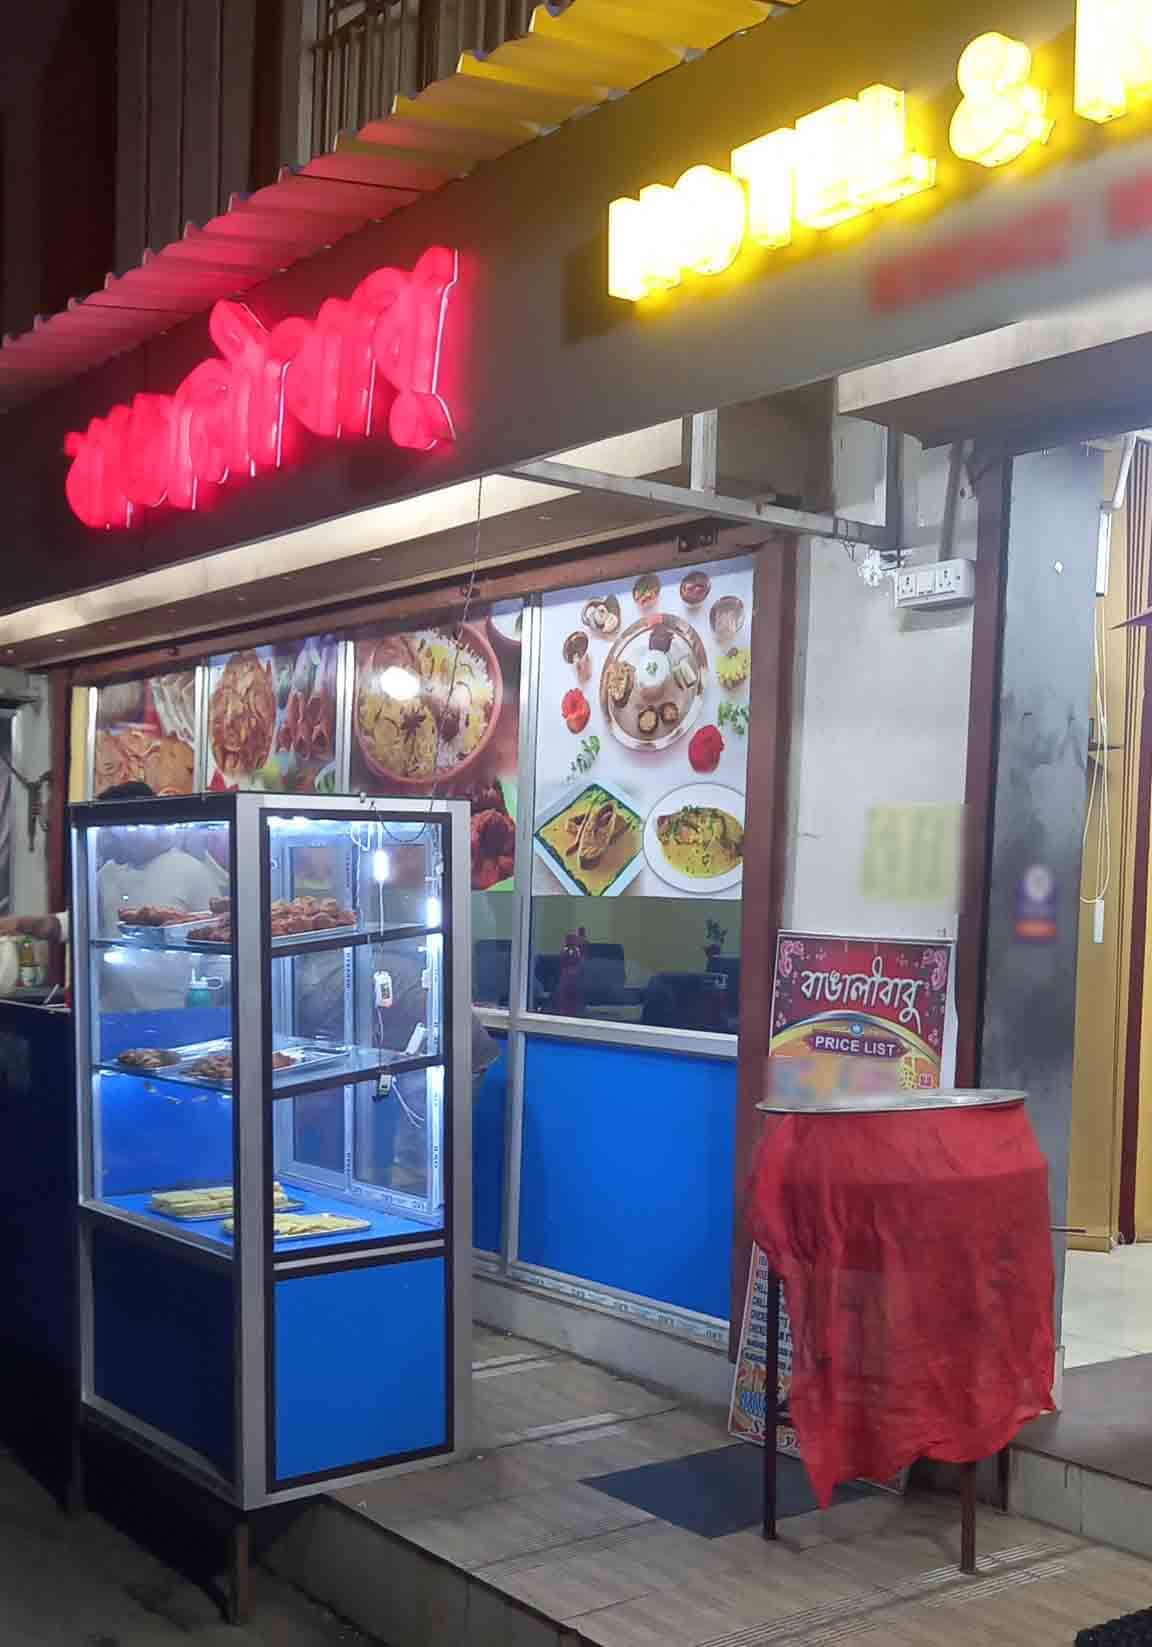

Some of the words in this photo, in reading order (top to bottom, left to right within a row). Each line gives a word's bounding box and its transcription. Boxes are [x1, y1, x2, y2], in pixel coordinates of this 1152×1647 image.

[949, 31, 1055, 168] &
[815, 1035, 860, 1053] PRICE
[864, 1042, 897, 1057] LIST
